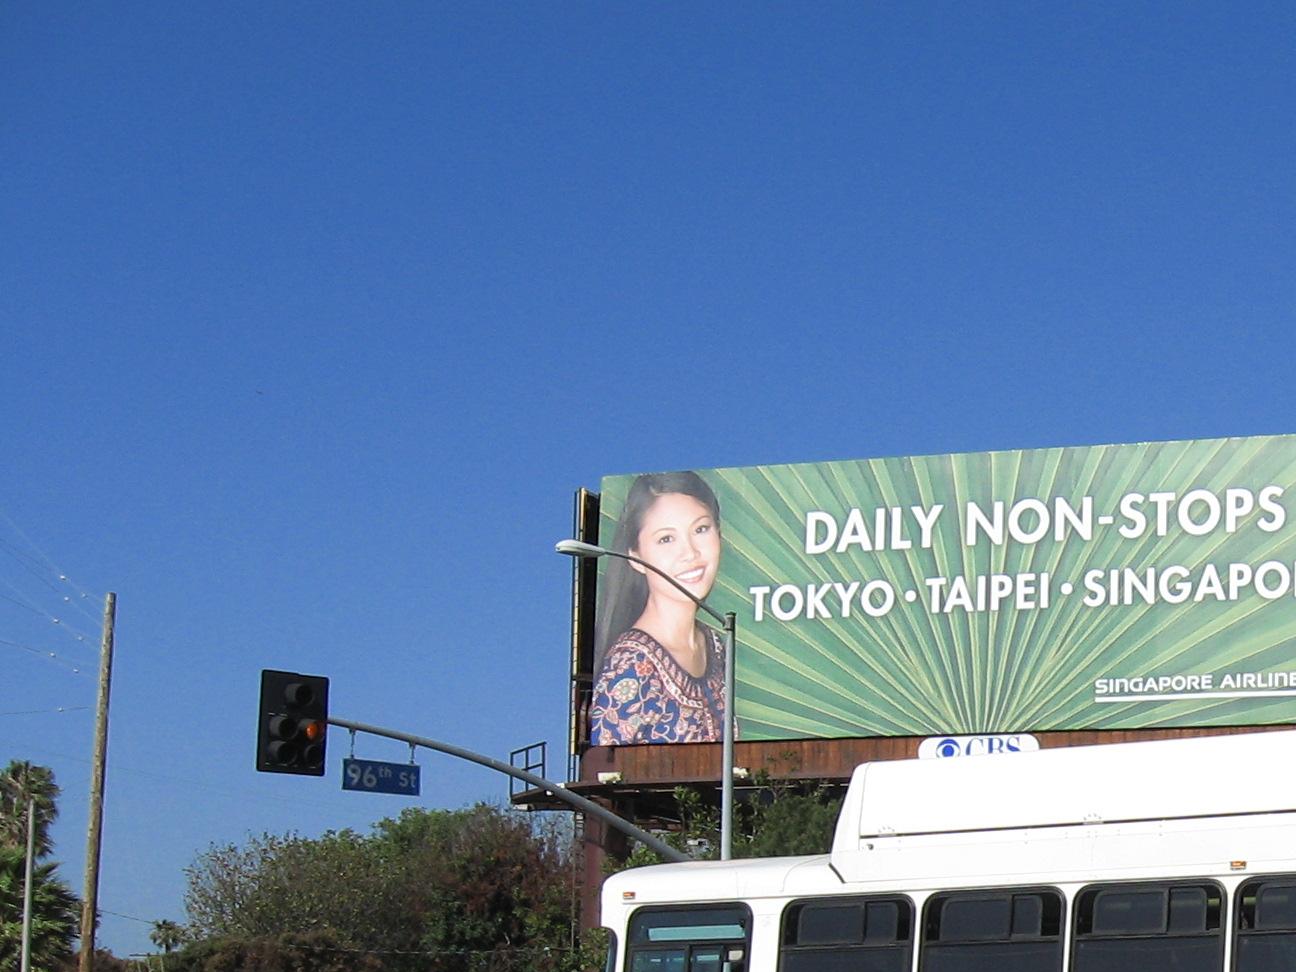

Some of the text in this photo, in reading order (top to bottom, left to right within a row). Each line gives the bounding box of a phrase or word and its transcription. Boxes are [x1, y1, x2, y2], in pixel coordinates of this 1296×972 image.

[806, 485, 1286, 554] DAILY NON-STOPS
[750, 580, 895, 621] TOKYO
[925, 573, 1050, 613] TAIPEI
[1095, 674, 1212, 694] SINGAPORE
[965, 736, 1021, 756] CBS
[346, 764, 417, 788] 96th St
